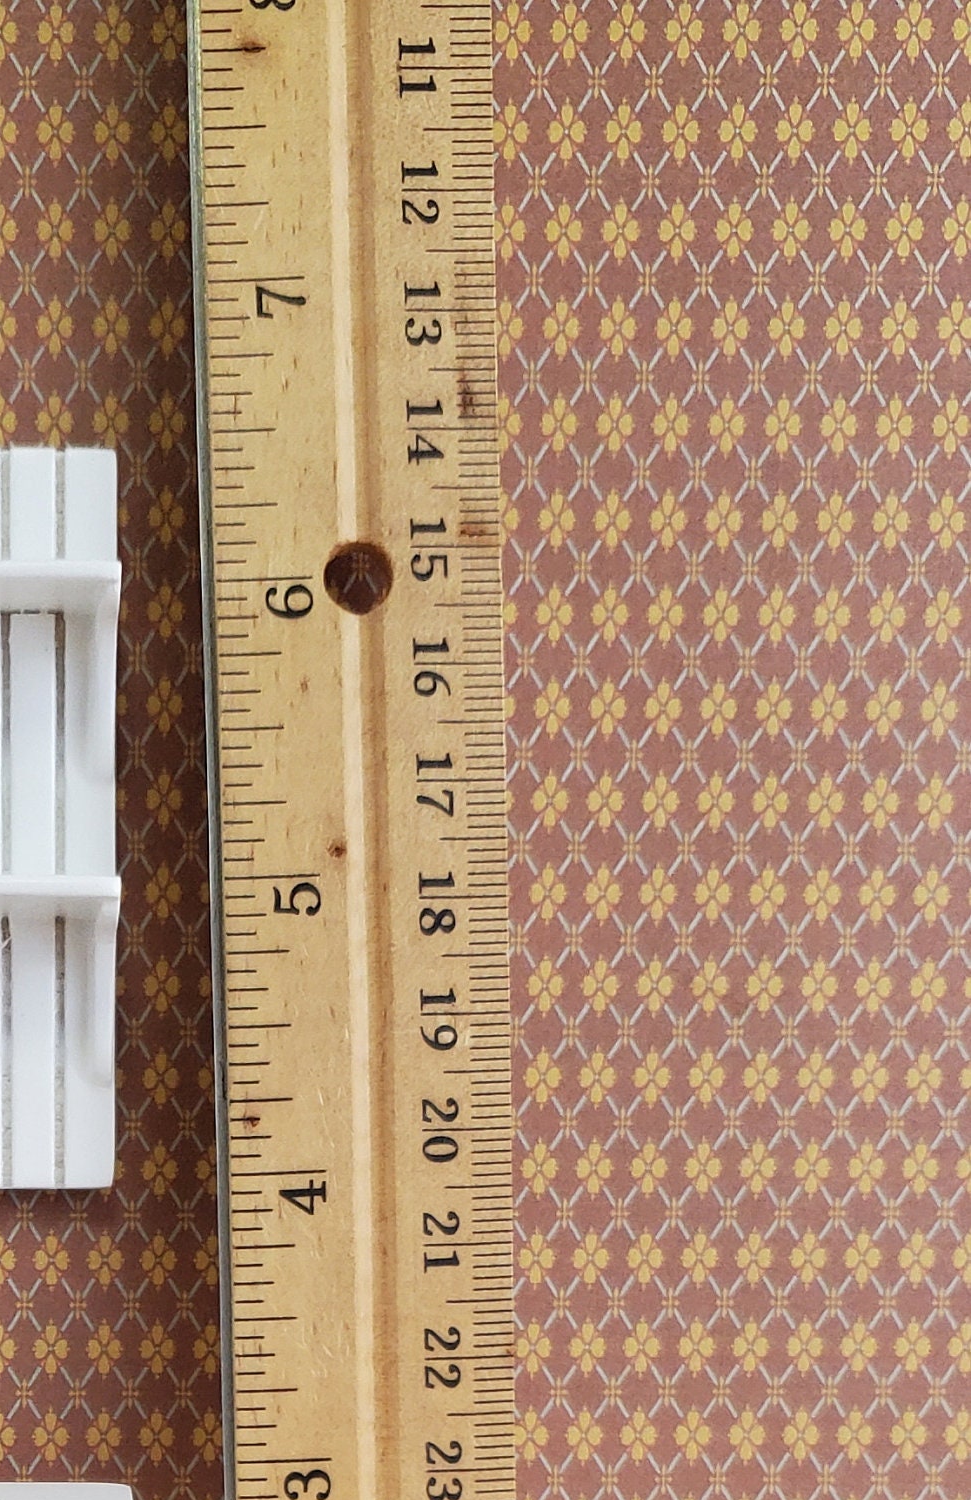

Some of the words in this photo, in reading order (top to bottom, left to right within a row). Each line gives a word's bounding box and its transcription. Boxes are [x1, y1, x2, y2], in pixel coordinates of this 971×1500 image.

[398, 37, 437, 98] 11
[401, 160, 440, 225] 12
[255, 285, 307, 319] 7
[404, 281, 442, 346] 13
[406, 399, 444, 465] 14
[409, 517, 448, 582] 15
[265, 583, 314, 619] 6
[412, 637, 451, 697] 16
[415, 752, 454, 817] 17
[272, 881, 322, 916] 5
[418, 871, 456, 936] 18
[419, 988, 458, 1051] 19
[421, 1097, 459, 1163] 20
[278, 1178, 327, 1216] 4
[422, 1211, 460, 1274] 21
[424, 1326, 462, 1389] 22
[283, 1468, 332, 1500] 3
